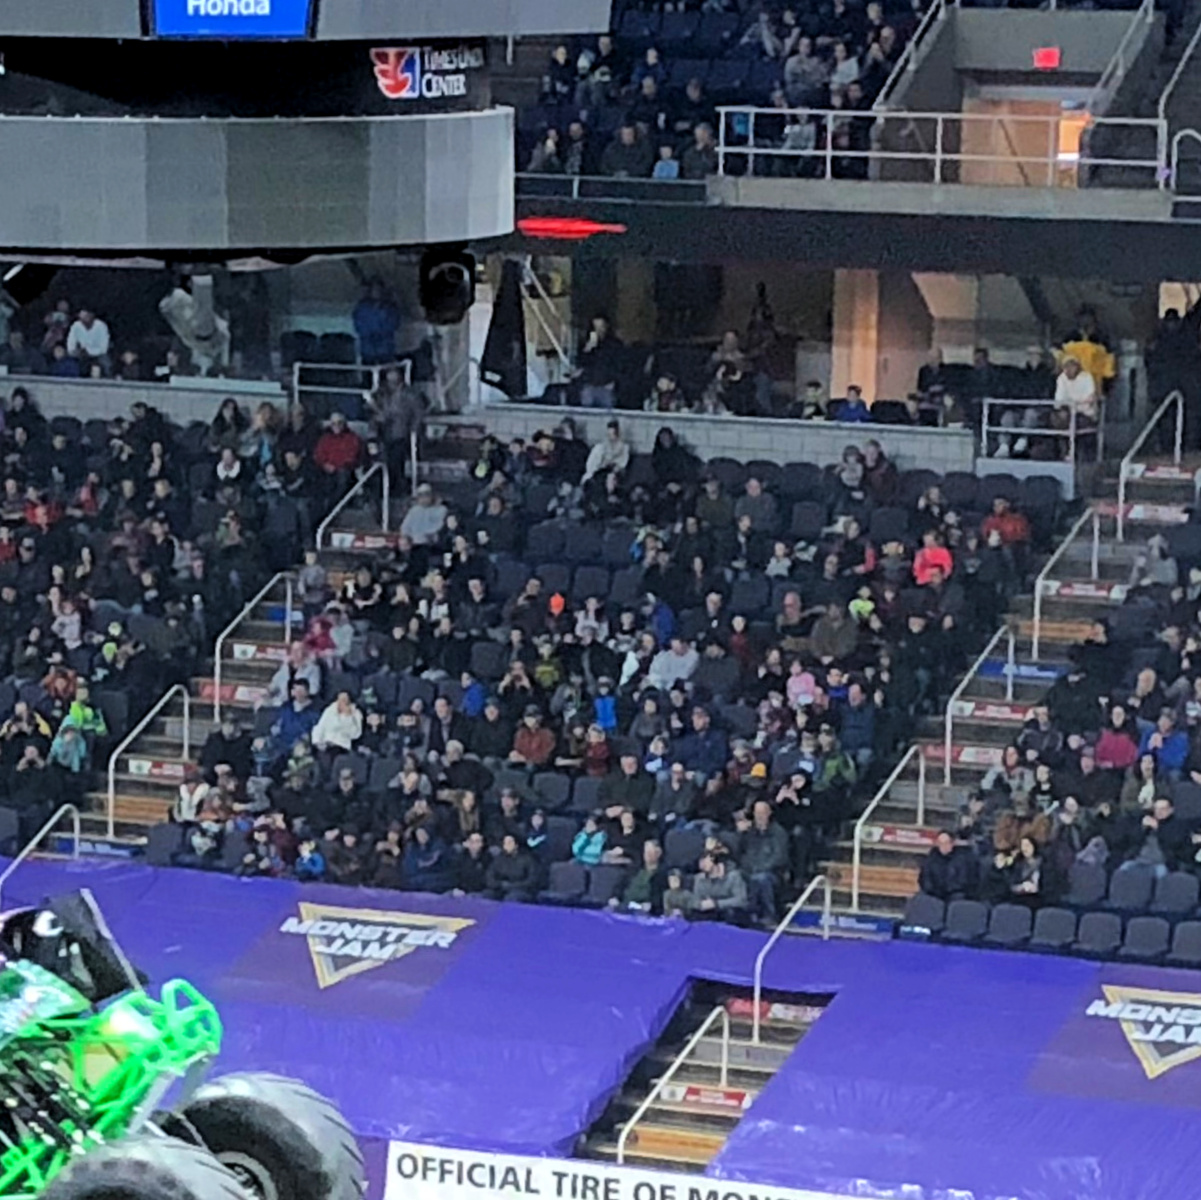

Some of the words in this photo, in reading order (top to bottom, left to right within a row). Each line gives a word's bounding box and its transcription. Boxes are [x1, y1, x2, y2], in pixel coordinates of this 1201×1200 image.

[186, 0, 270, 16] Honda
[422, 72, 467, 98] CENTER
[279, 916, 458, 949] MONSTER
[314, 937, 398, 960] JAM
[396, 1153, 540, 1195] OFFICIAL
